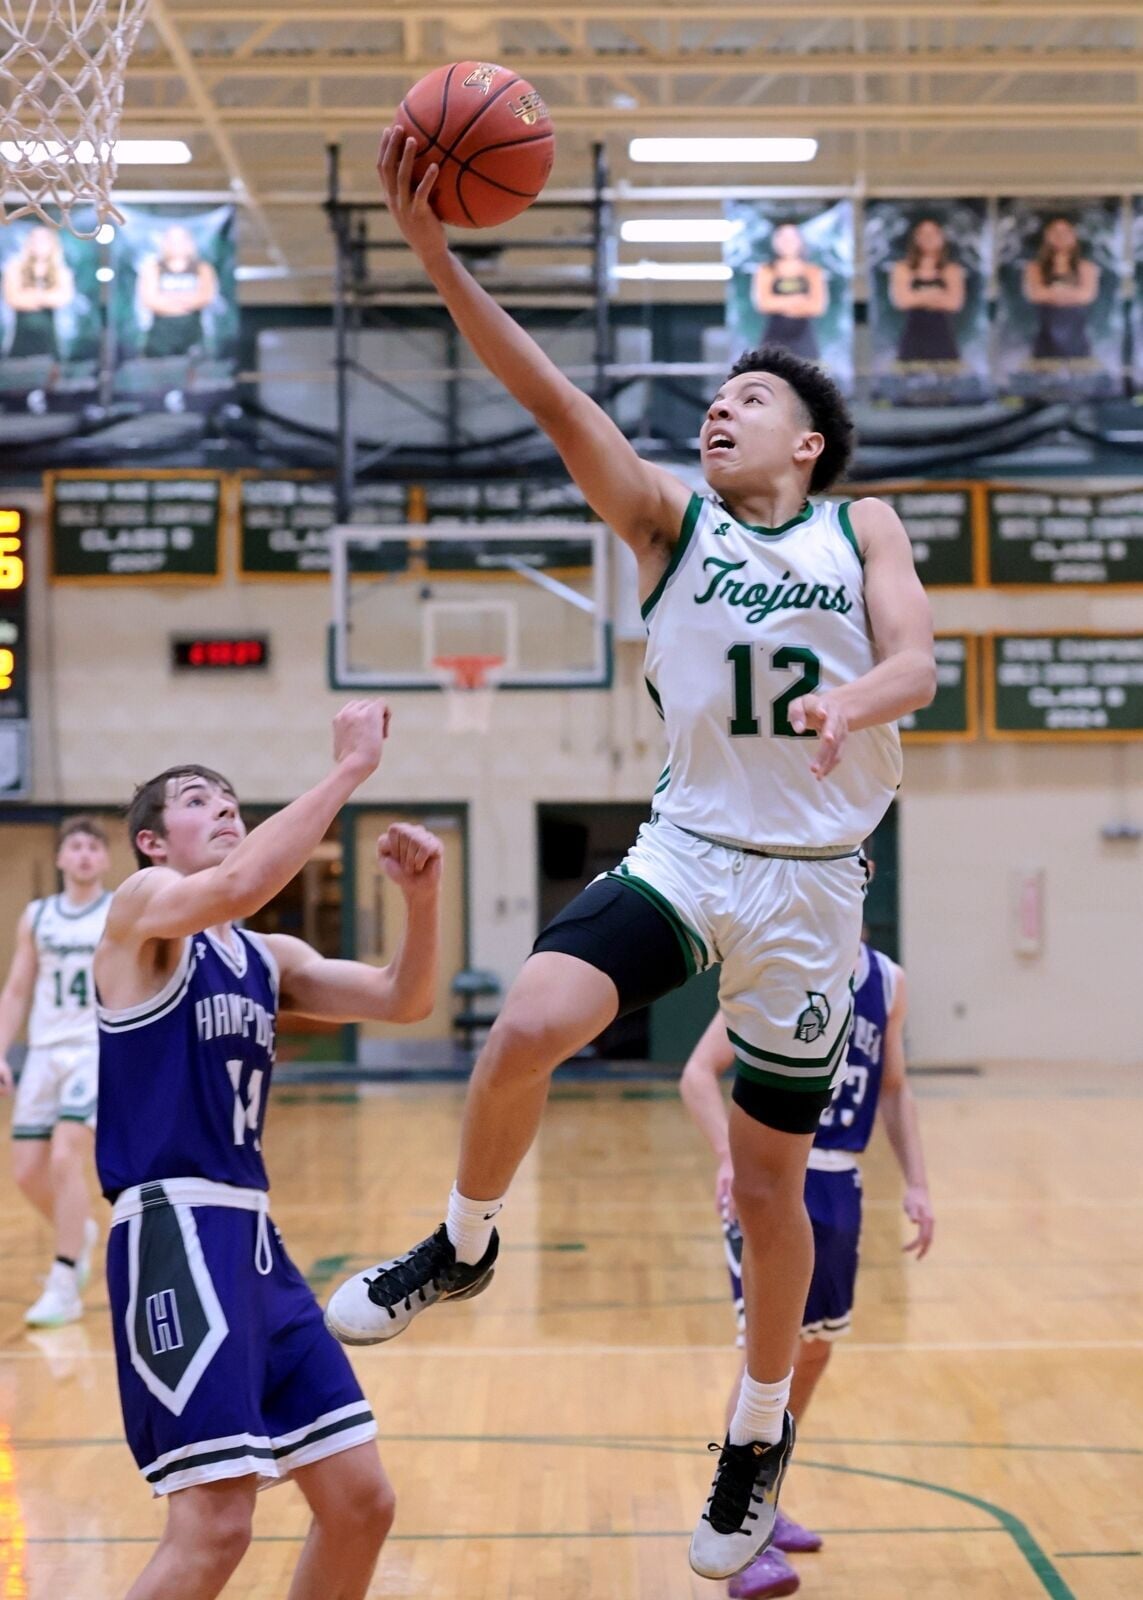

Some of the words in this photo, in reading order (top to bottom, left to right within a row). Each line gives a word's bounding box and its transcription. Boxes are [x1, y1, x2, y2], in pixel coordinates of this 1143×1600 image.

[694, 556, 853, 624] Trojans
[725, 641, 822, 739] 12
[54, 968, 88, 1009] 14
[146, 1288, 184, 1355] H
